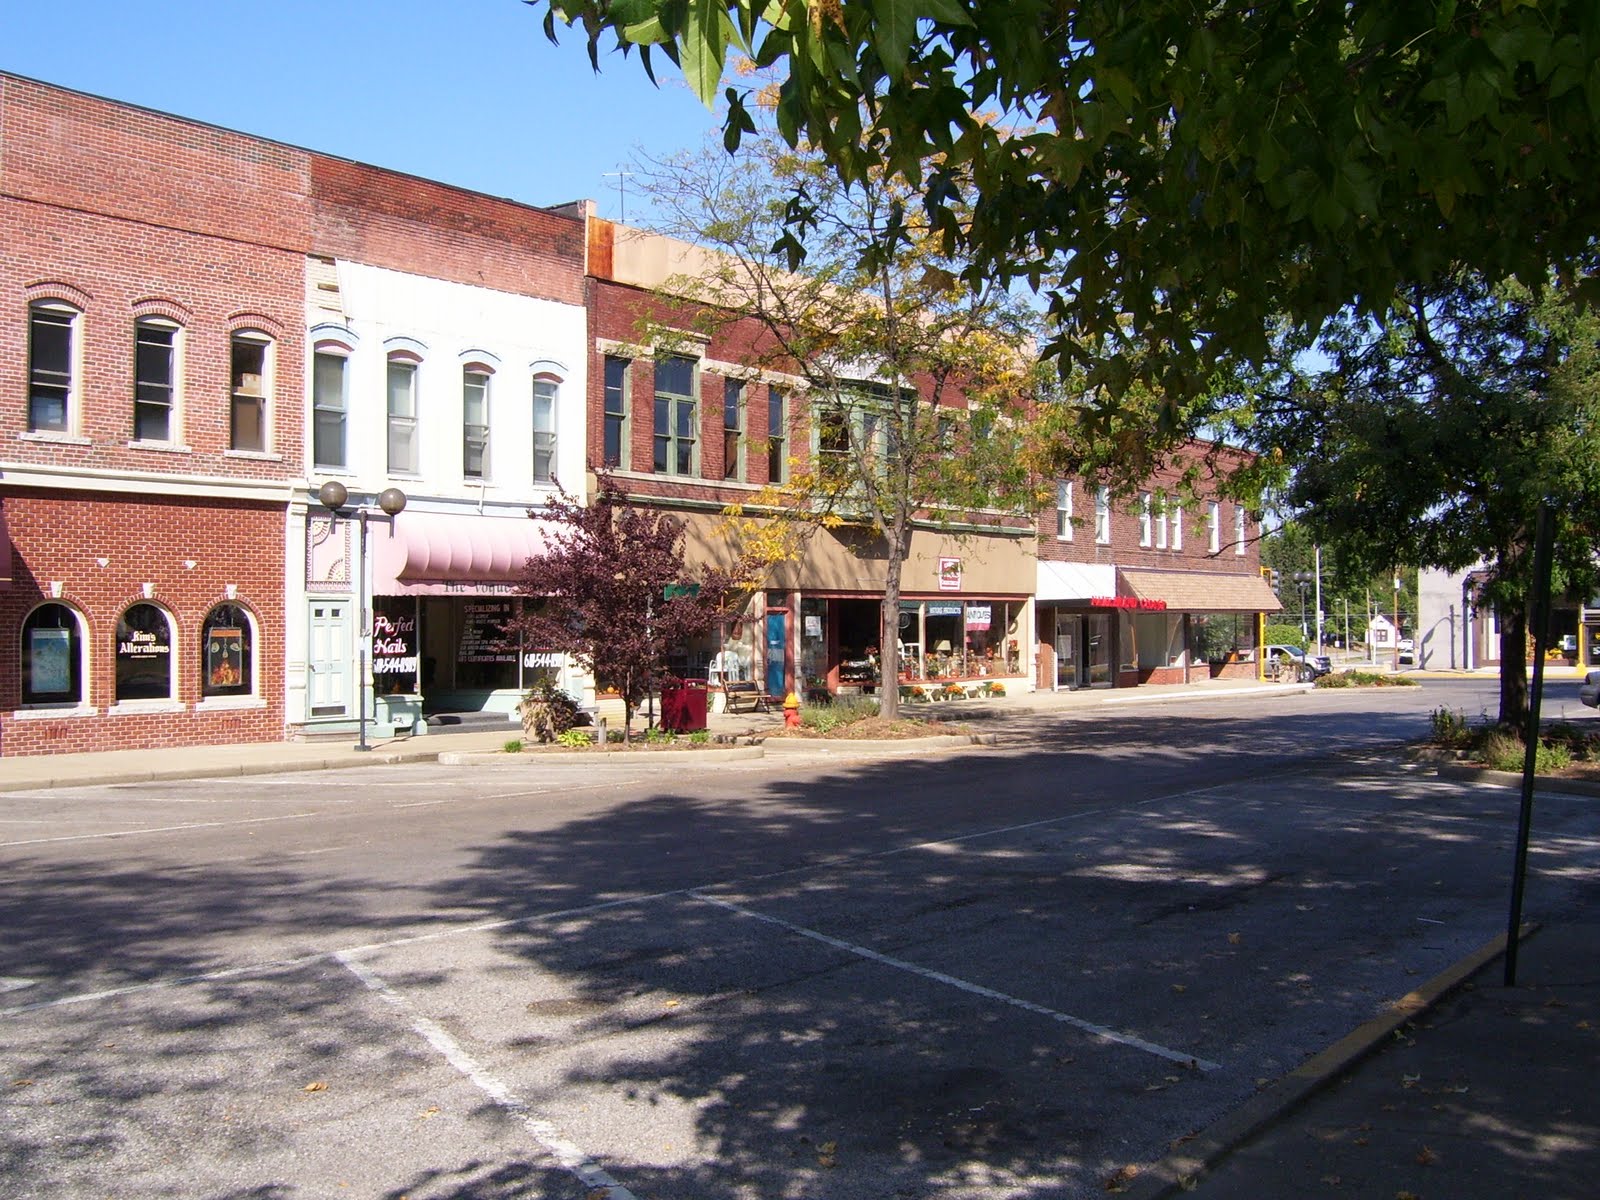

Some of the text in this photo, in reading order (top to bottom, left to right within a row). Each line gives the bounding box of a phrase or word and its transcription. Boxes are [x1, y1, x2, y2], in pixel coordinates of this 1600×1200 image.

[443, 580, 512, 596] The Vogue
[131, 631, 156, 641] Kim's
[119, 642, 169, 653] Alterations
[373, 637, 408, 654] Nails
